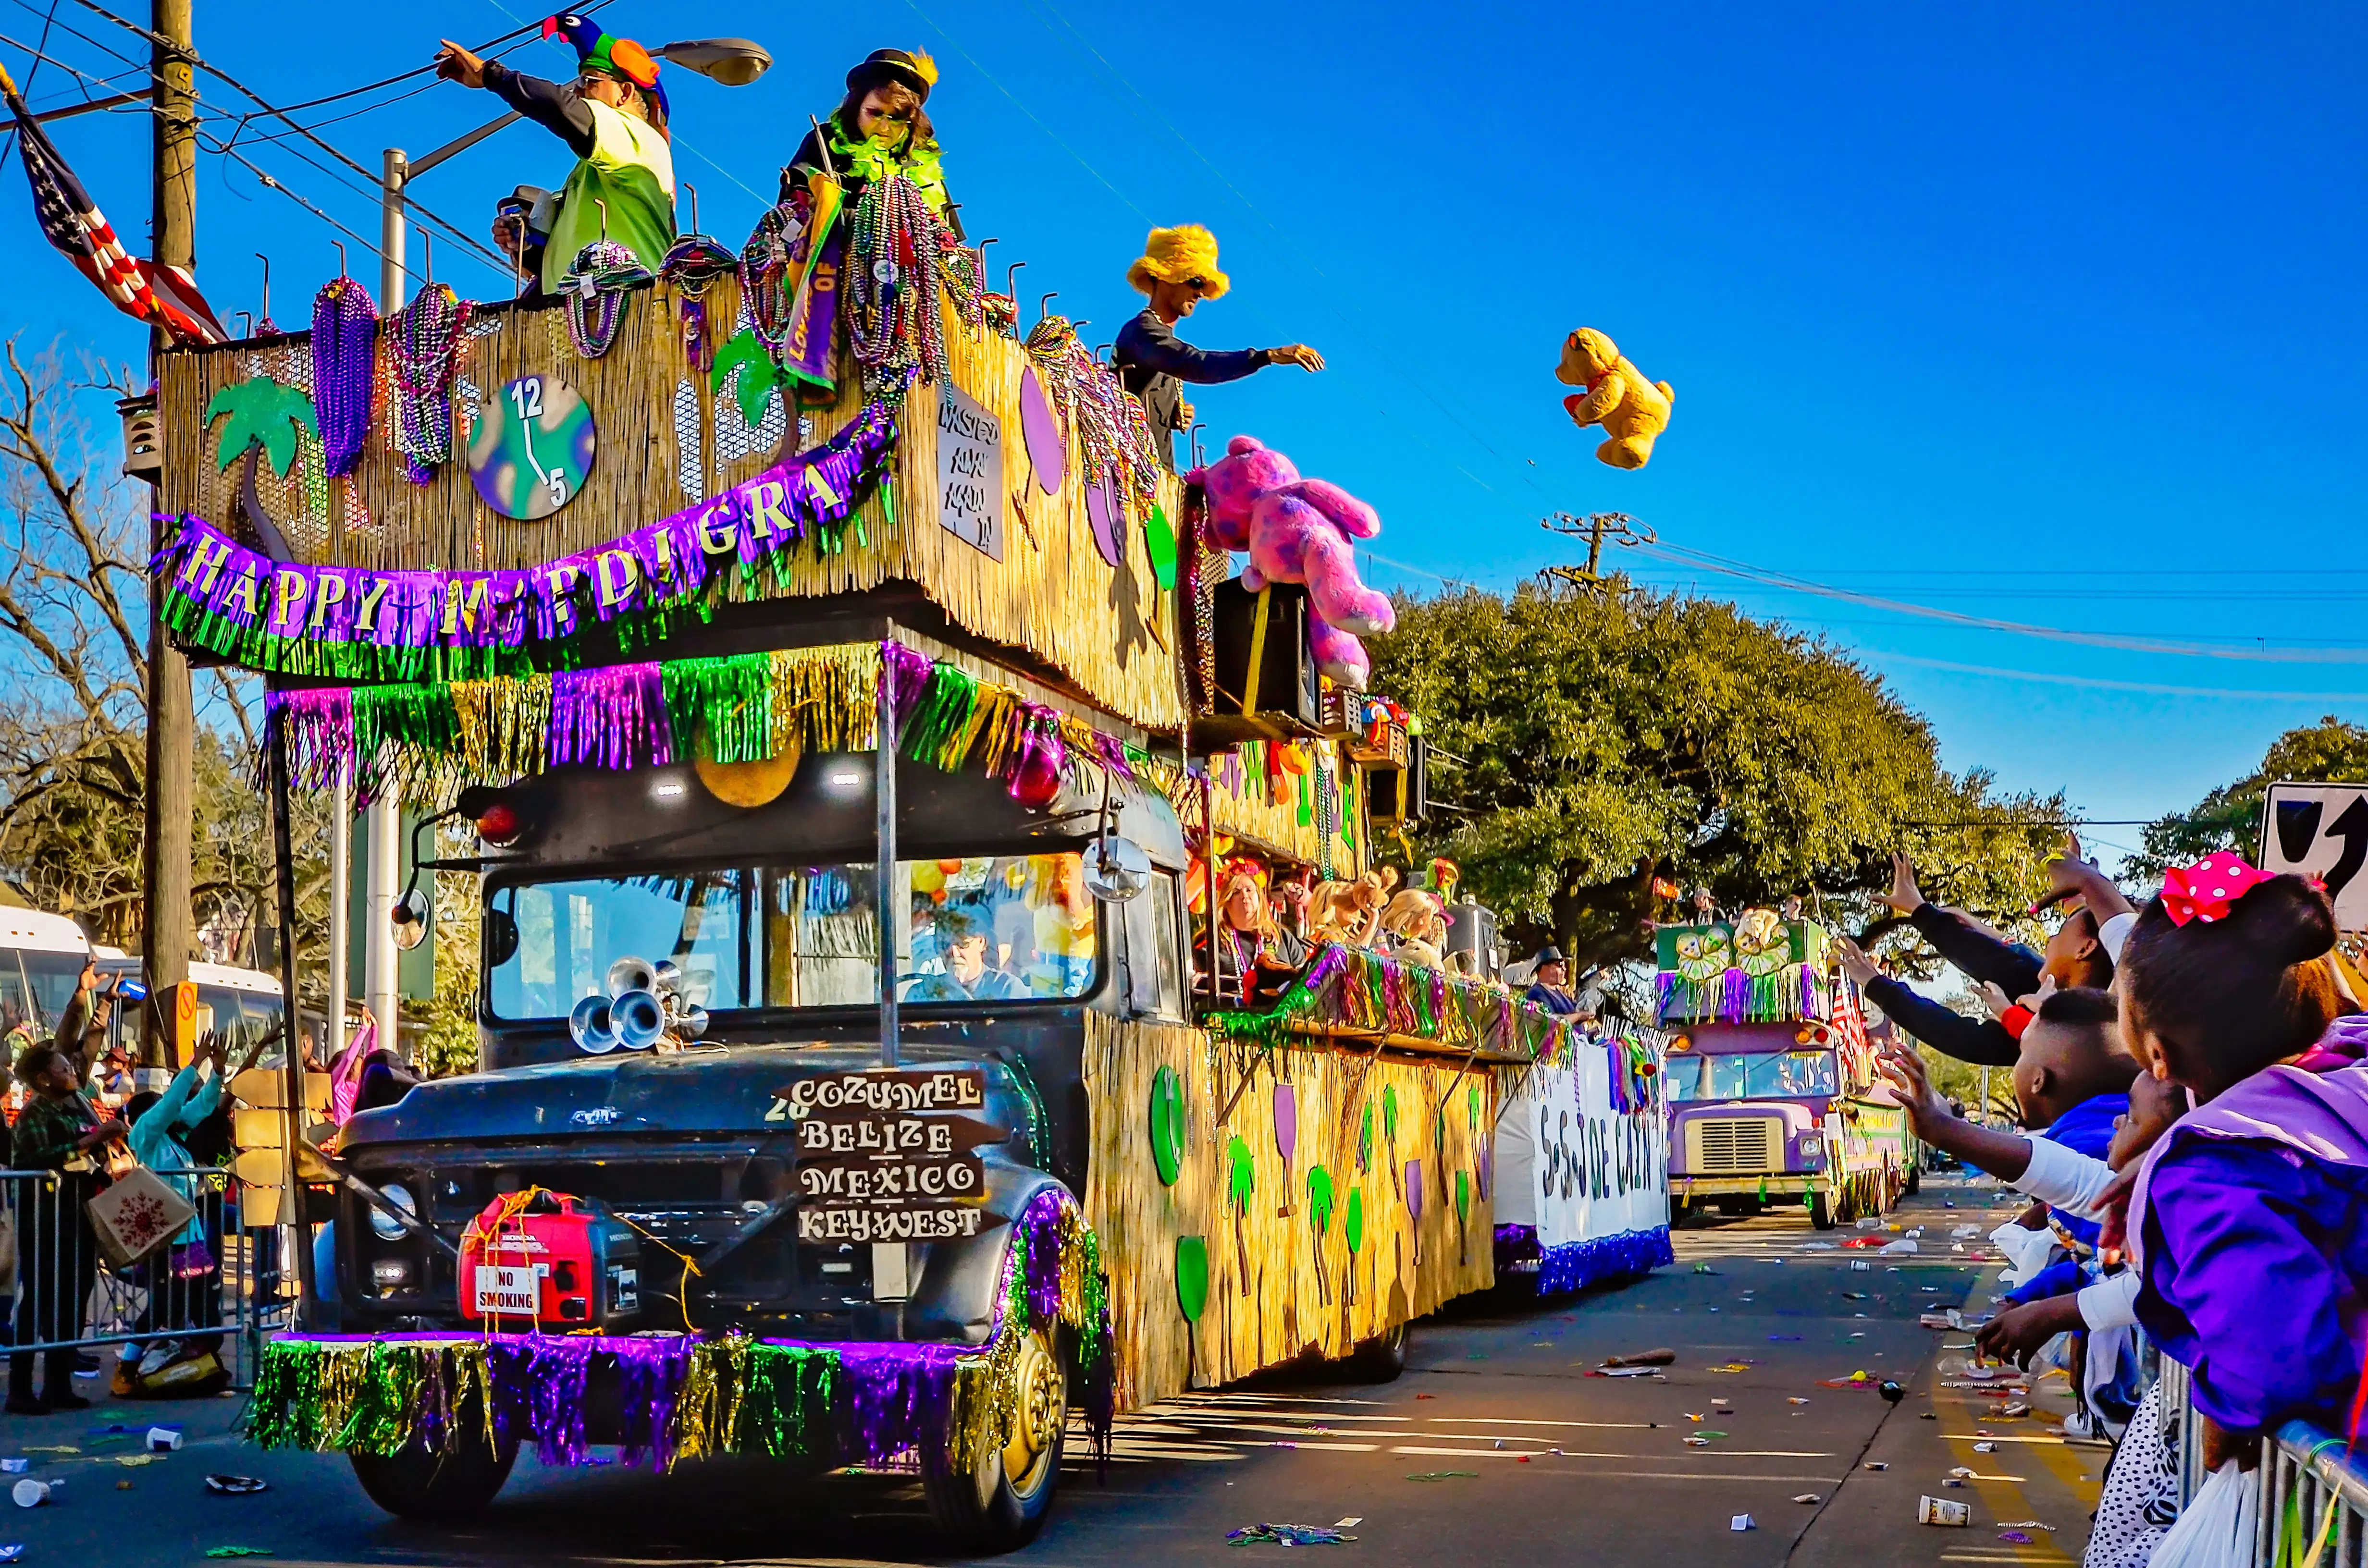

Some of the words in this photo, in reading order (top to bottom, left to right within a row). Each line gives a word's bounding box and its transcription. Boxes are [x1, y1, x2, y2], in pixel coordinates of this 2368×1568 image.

[814, 262, 838, 291] OF
[511, 378, 543, 419] 12
[550, 467, 567, 507] 5
[185, 531, 391, 631] HAPPY
[791, 1074, 981, 1110] COZUMEL
[799, 1120, 952, 1152] BELIZE
[800, 1163, 975, 1198] MEXICO
[609, 1233, 634, 1242] HONDA
[498, 1271, 514, 1286] NO
[479, 1291, 533, 1309] SMOKING
